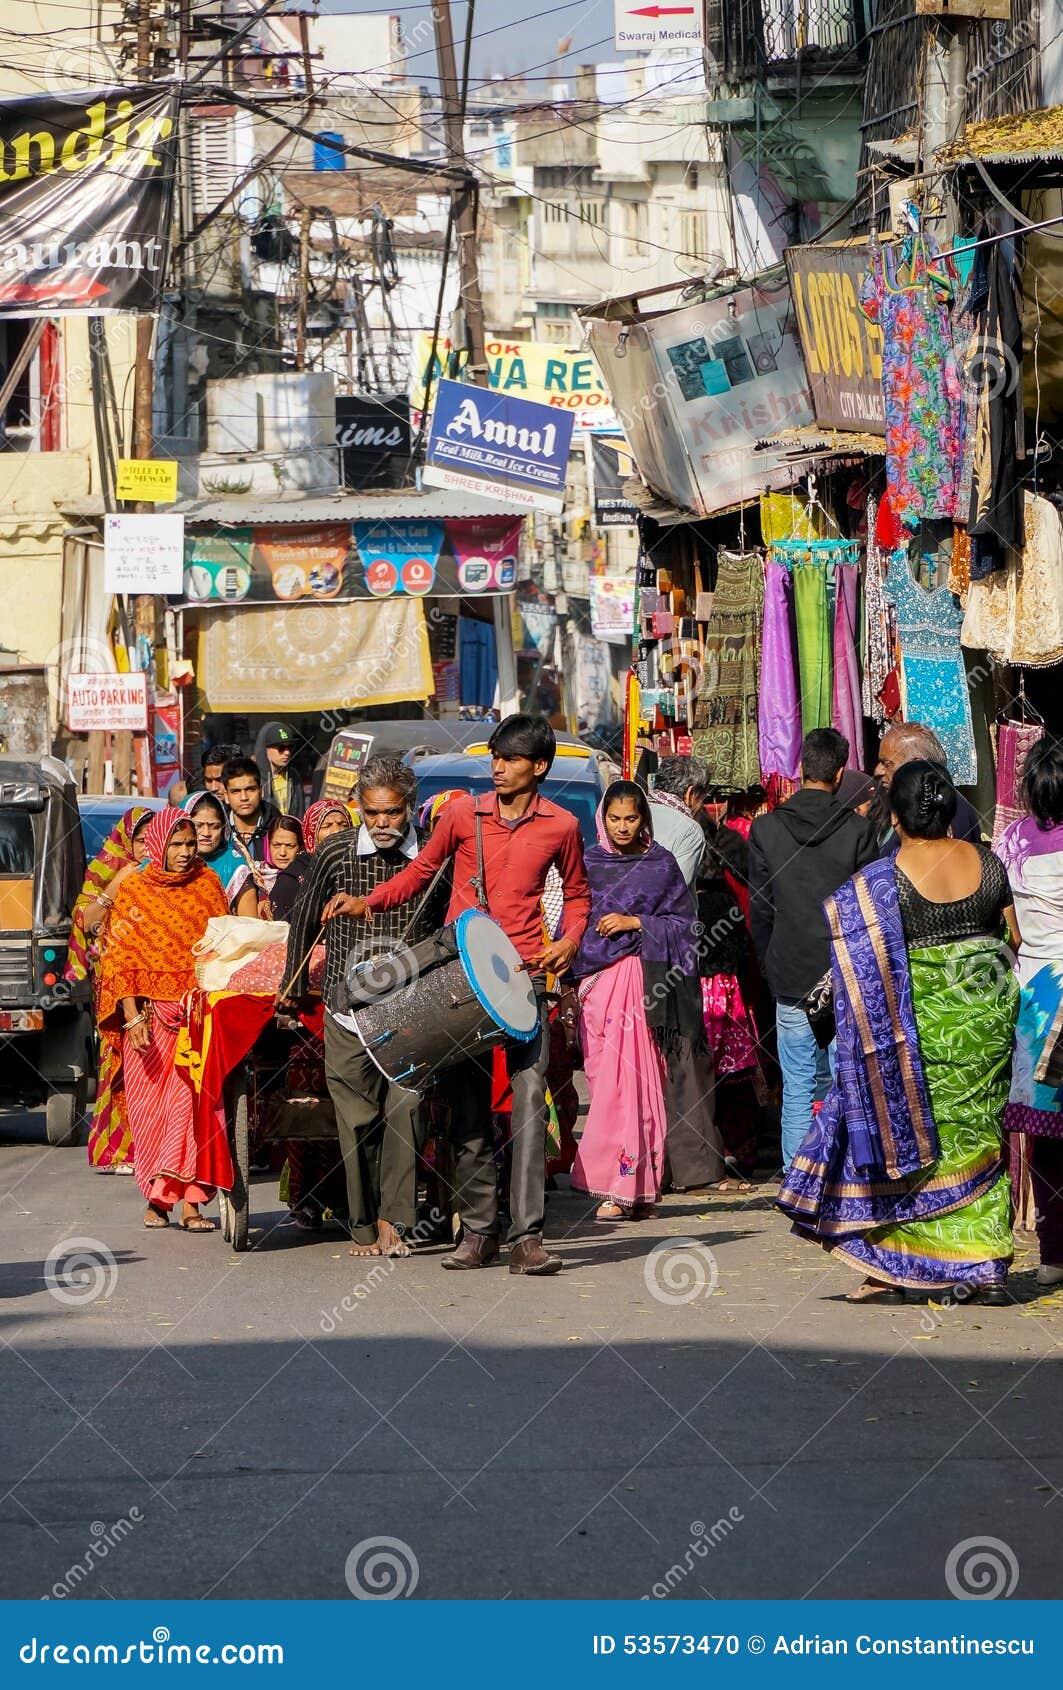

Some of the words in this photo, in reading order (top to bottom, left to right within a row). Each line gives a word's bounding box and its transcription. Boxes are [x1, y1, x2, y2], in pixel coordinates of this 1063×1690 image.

[619, 31, 656, 41] Swaraj
[0, 100, 173, 183] ndir
[794, 272, 863, 379] LOTUS
[544, 359, 605, 393] RE
[549, 393, 610, 408] ROO
[840, 391, 857, 419] CITY
[857, 392, 884, 421] PALACE
[446, 398, 557, 458] Amul
[435, 441, 460, 455] Real
[508, 460, 526, 472] Ice
[443, 474, 482, 490] SHREE
[484, 484, 535, 504] KRISHNA
[409, 525, 429, 537] Card
[72, 688, 98, 706] AUTO
[101, 688, 145, 706] PARKING
